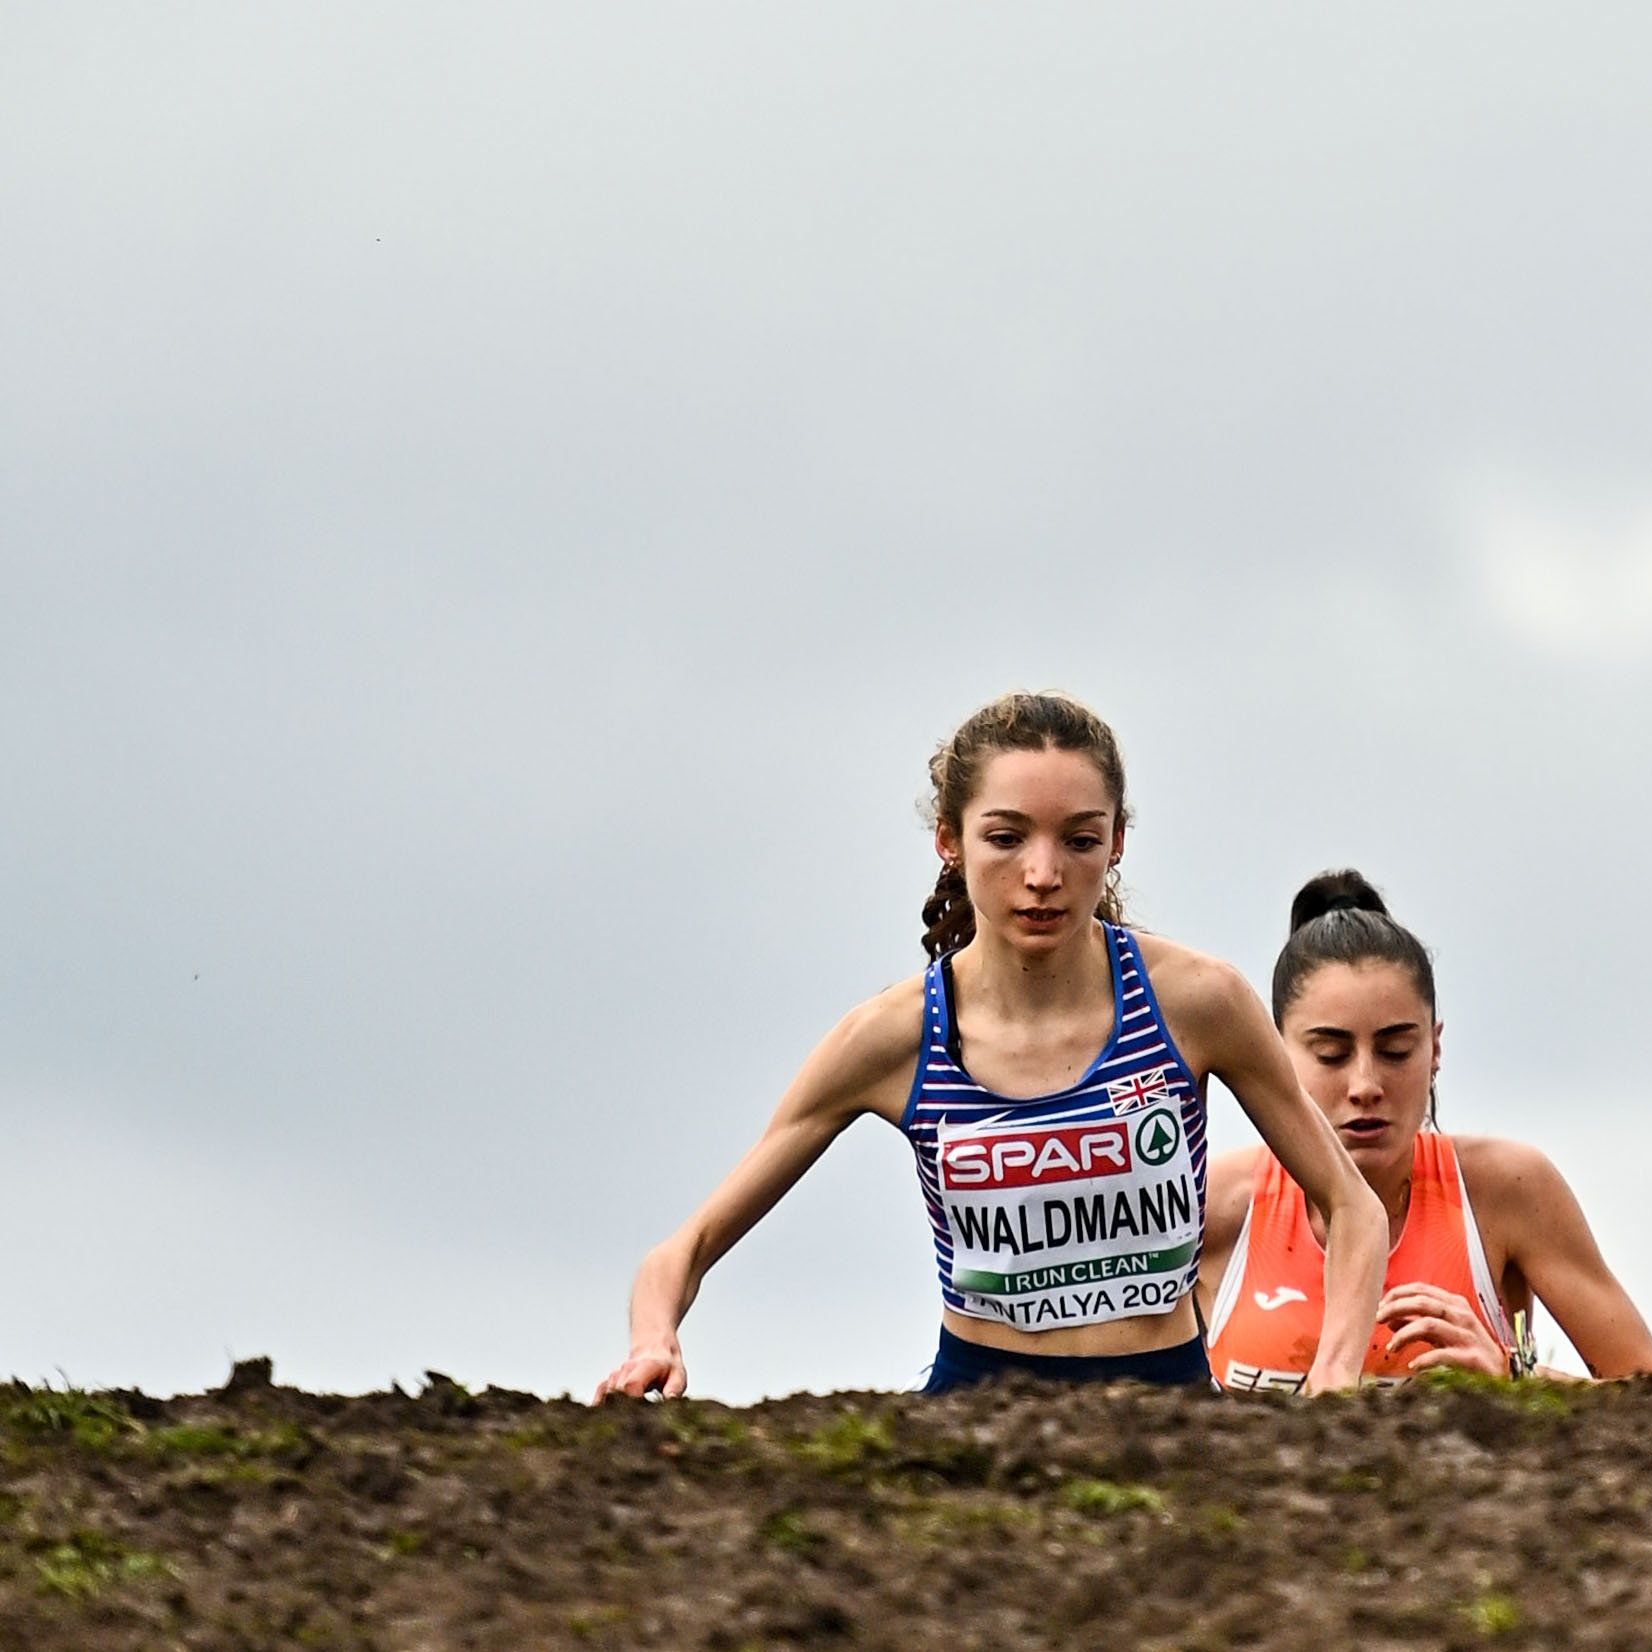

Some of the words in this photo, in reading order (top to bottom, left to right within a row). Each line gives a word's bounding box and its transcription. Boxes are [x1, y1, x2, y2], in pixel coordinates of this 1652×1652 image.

[946, 1130, 1125, 1184] SPAR
[950, 1173, 1192, 1256] WALDMANN
[1004, 1276, 1010, 1293] I
[1016, 1267, 1066, 1292] RUN
